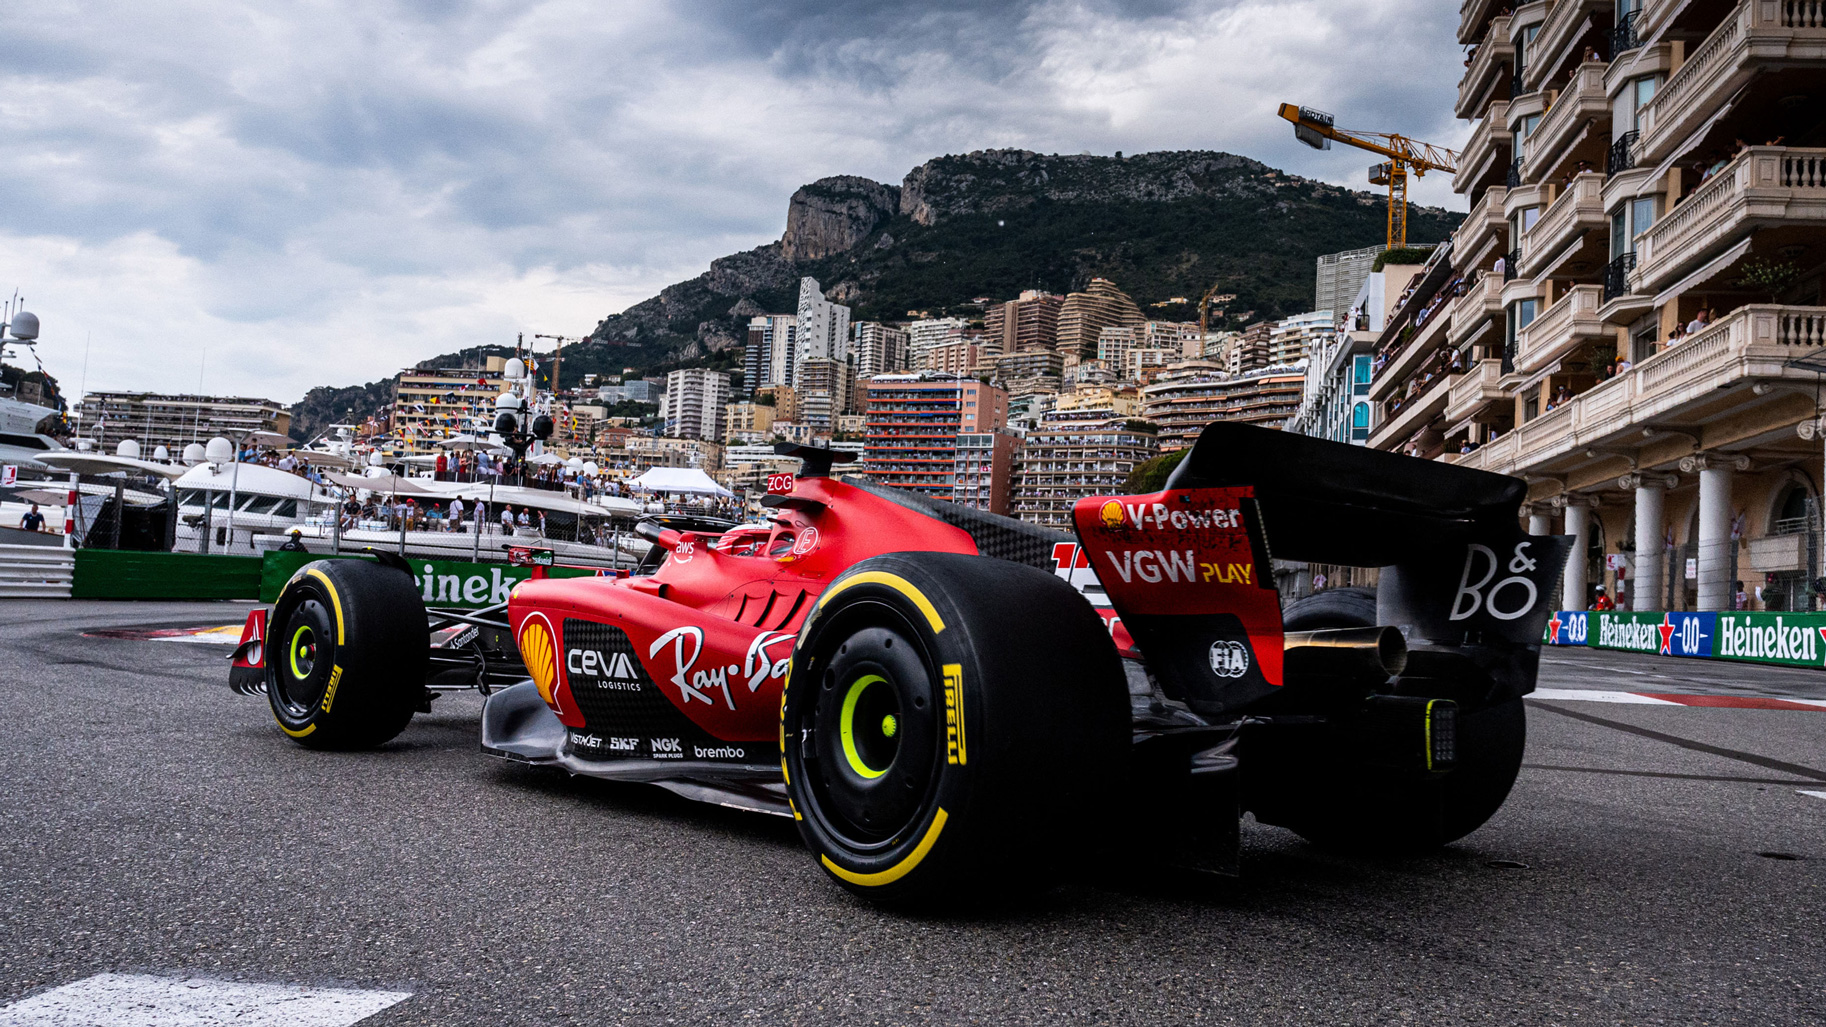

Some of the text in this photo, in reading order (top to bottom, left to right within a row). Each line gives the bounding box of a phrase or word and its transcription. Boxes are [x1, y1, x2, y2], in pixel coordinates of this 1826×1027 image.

[767, 475, 792, 491] ZCG
[1126, 503, 1240, 531] V-Power
[675, 540, 695, 555] aws
[1105, 549, 1252, 584] VGW PLAY
[1598, 613, 1657, 650] Heineken
[1720, 616, 1818, 661] Heineken
[321, 663, 344, 714] PIRELLI
[597, 680, 642, 692] LOGISTICS
[942, 663, 968, 766] PIRELLI
[609, 737, 640, 750] SKF
[650, 737, 683, 752] NGK
[693, 745, 746, 758] brembo
